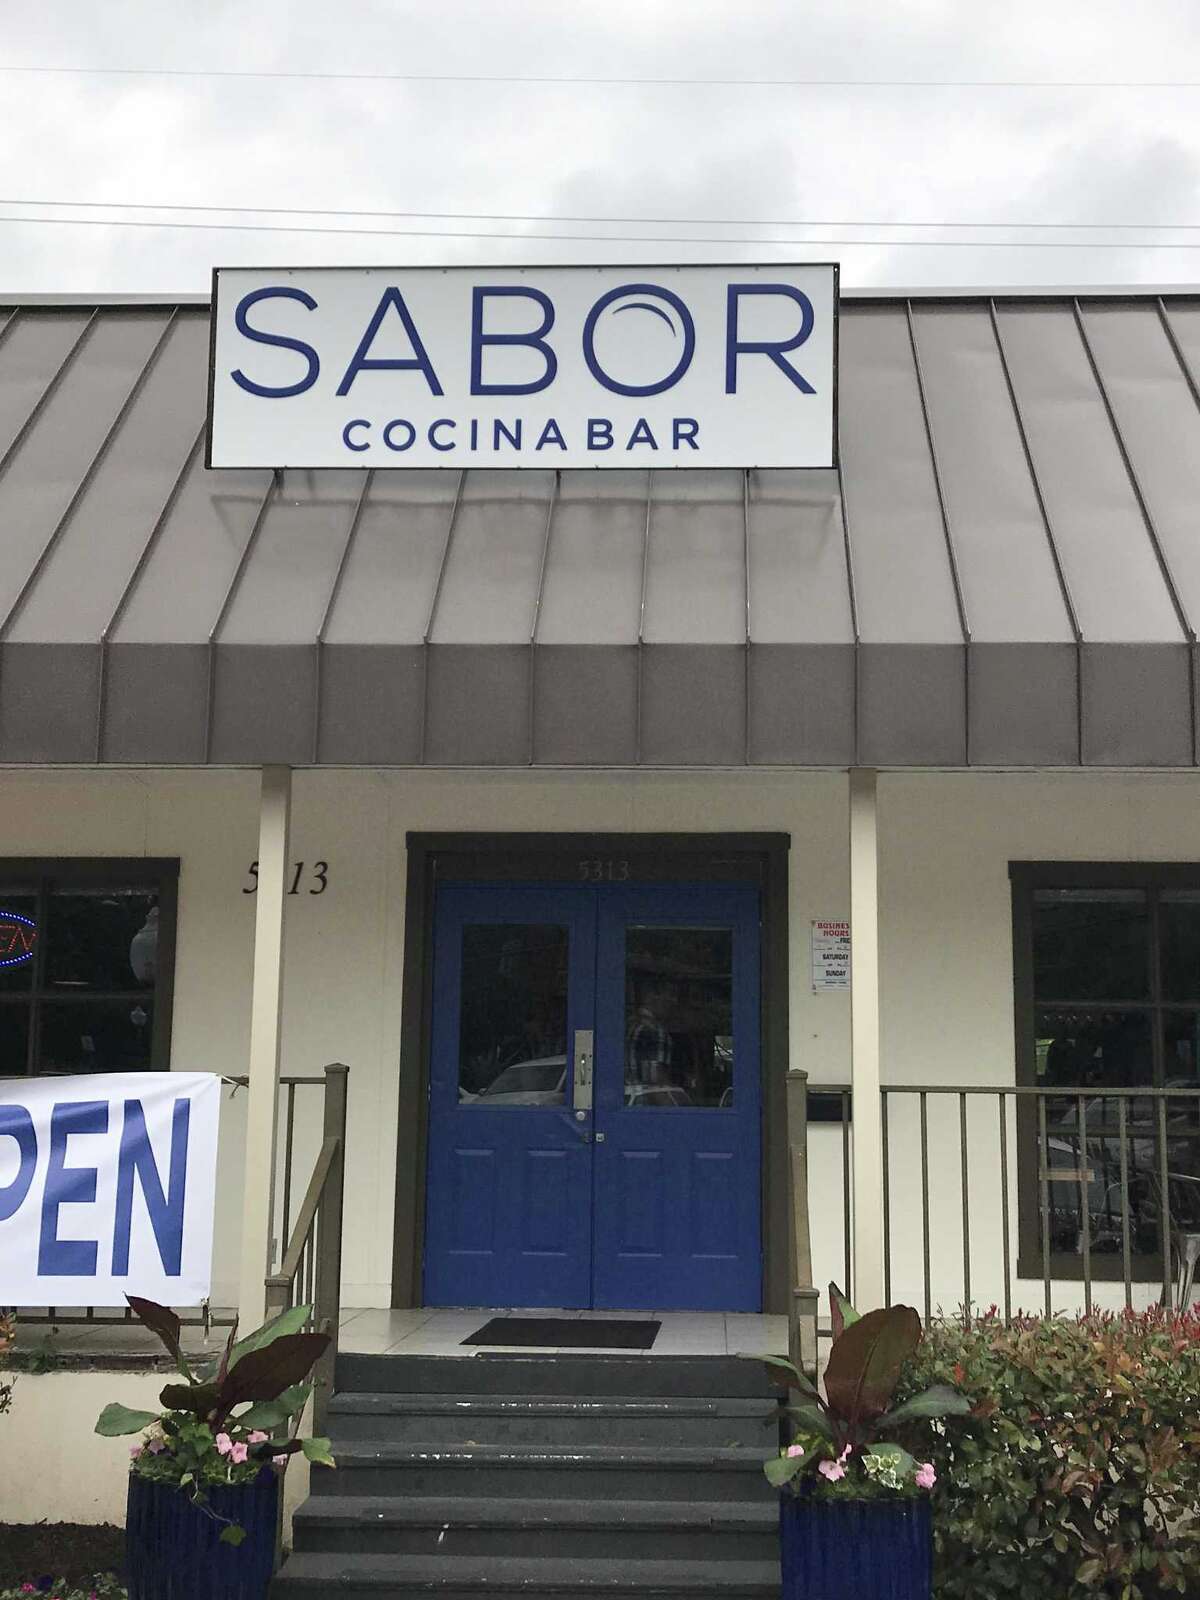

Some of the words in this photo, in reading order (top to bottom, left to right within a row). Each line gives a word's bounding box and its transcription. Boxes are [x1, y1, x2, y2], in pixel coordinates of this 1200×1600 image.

[229, 282, 818, 399] SABOR
[242, 861, 329, 895] 513
[578, 860, 630, 881] 5313
